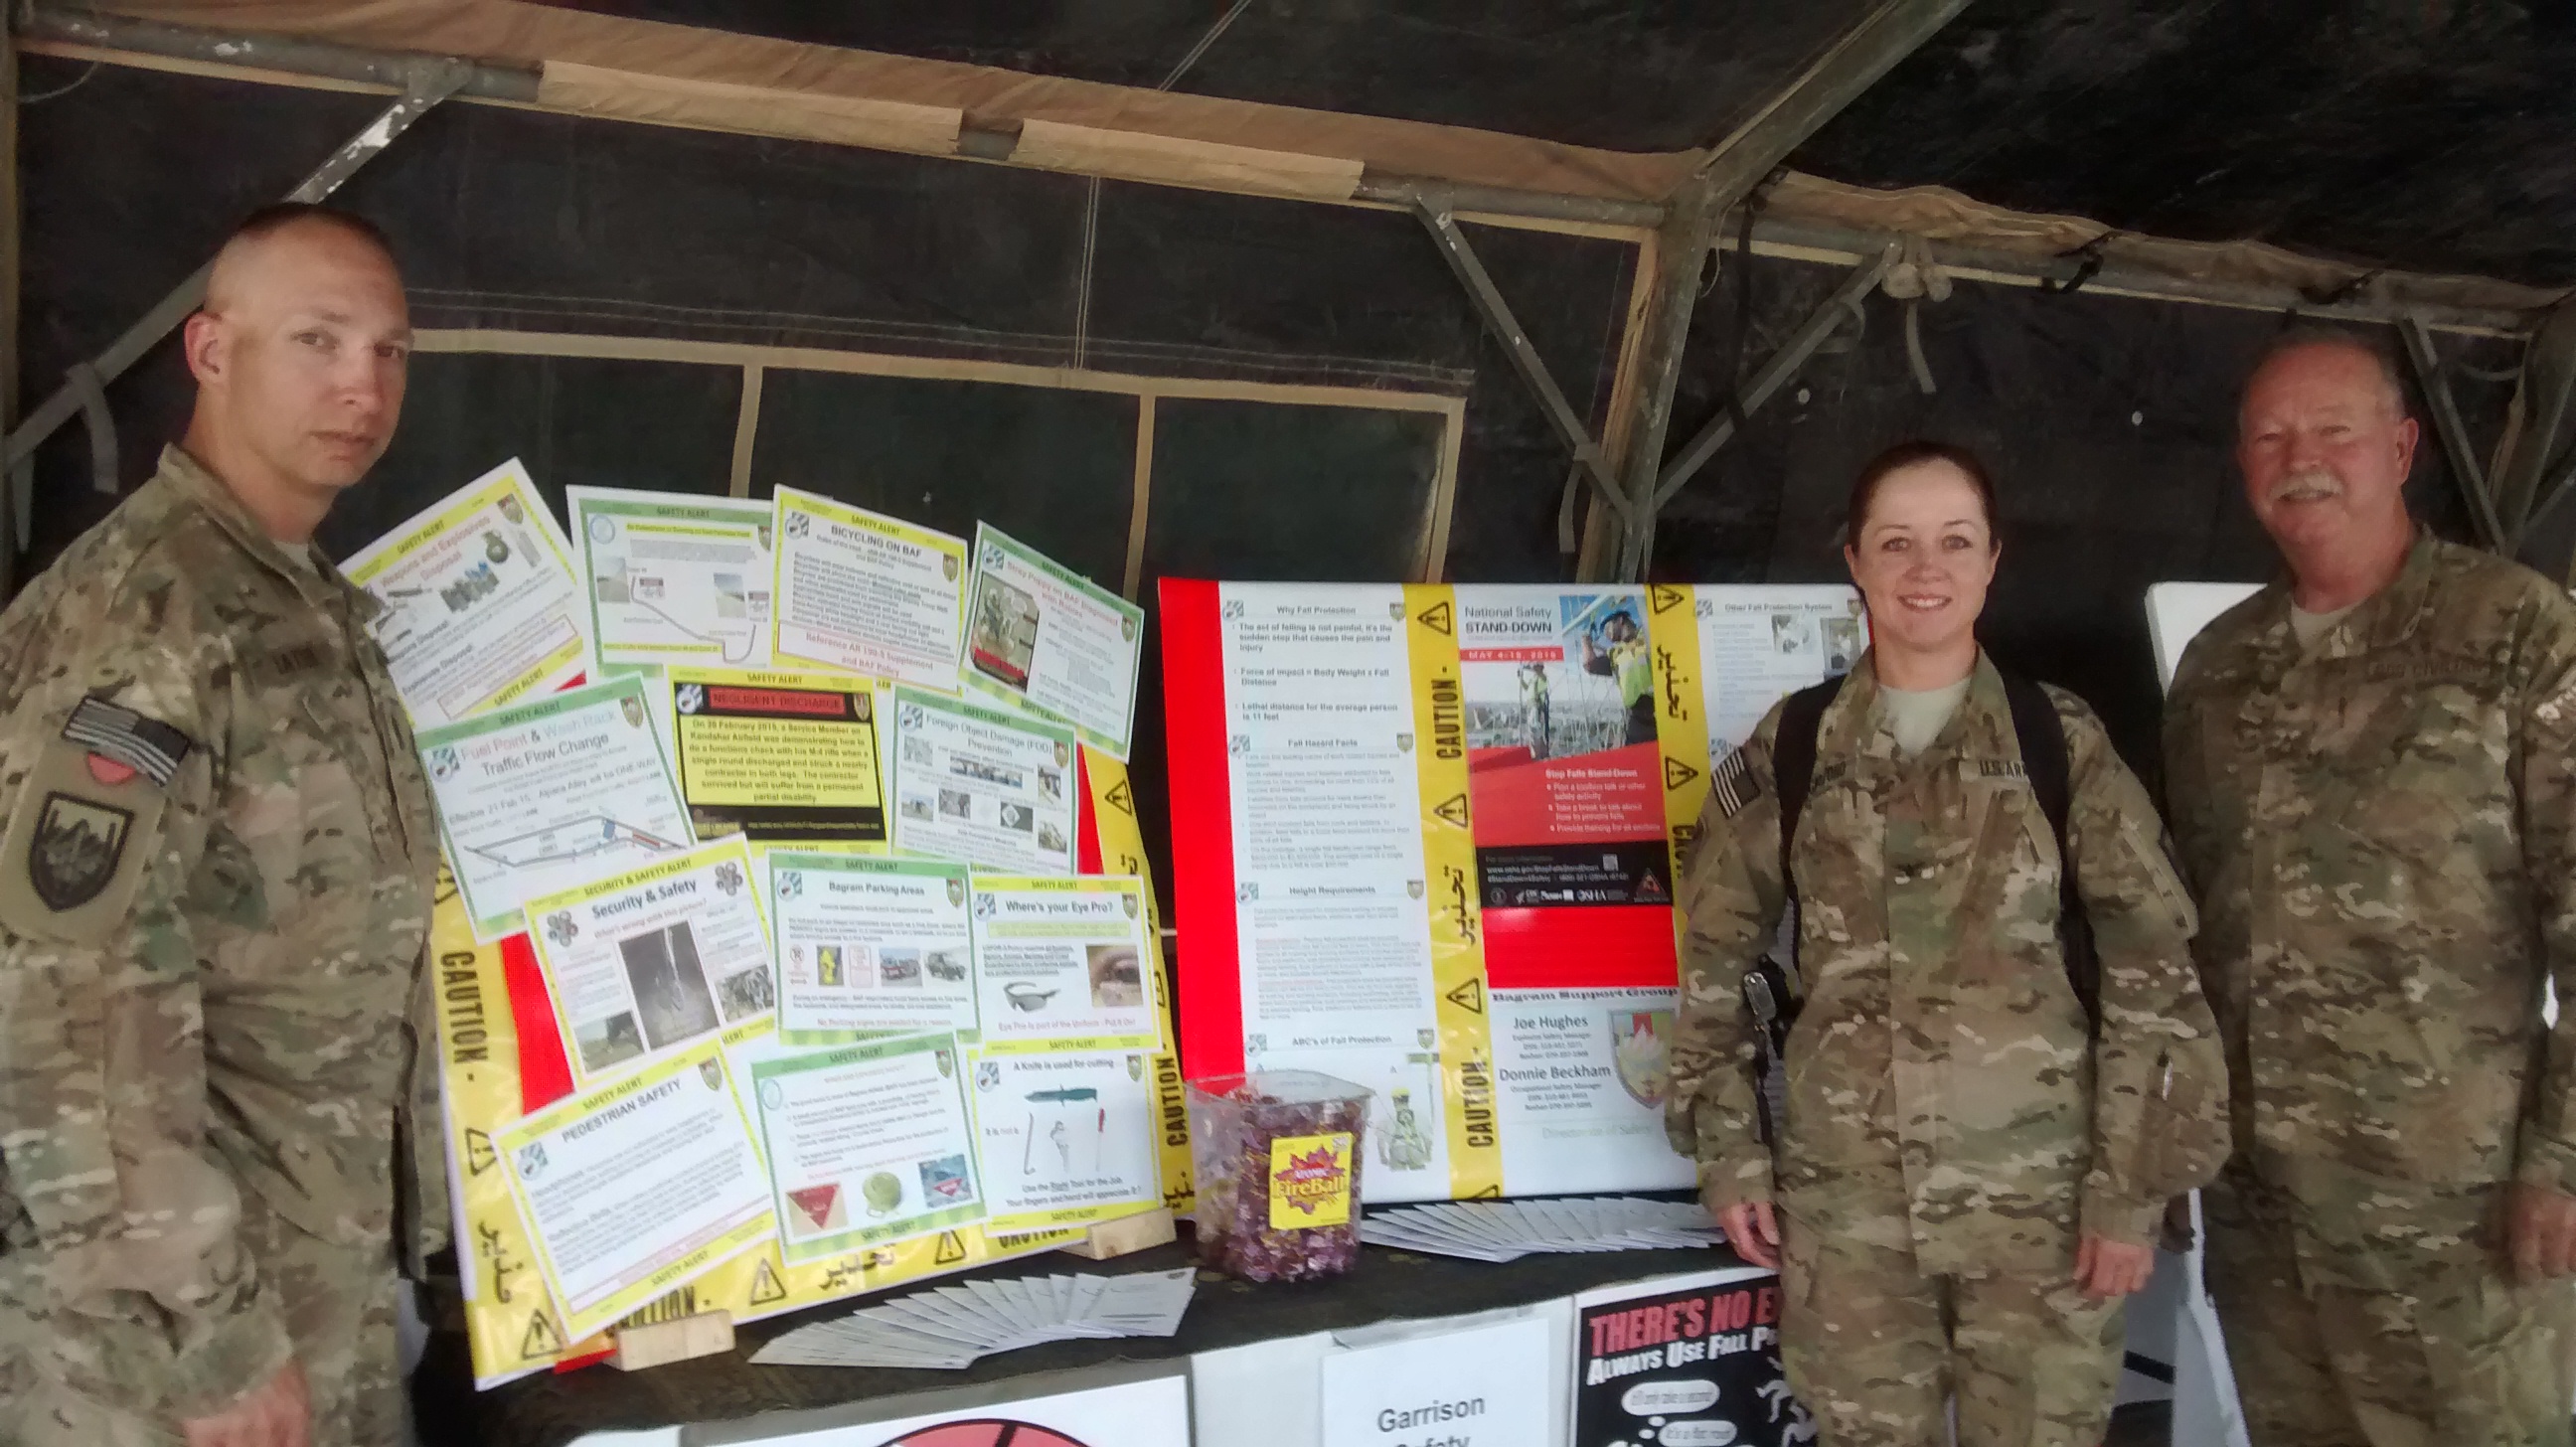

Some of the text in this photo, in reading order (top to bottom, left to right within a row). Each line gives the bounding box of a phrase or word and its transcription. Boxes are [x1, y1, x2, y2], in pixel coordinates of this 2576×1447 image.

[831, 525, 922, 558] BICYCLING ON BAF
[1465, 606, 1551, 619] National Safety
[747, 674, 803, 684] SAFETY ALERT
[461, 709, 617, 761] Fuel Point & Wash Rack
[1431, 679, 1463, 760] CAUTION
[482, 753, 523, 777] Traffic
[525, 745, 557, 765] Flow
[559, 732, 610, 758] Change
[2006, 760, 2024, 777] AR
[591, 879, 697, 919] Security & Safety
[829, 881, 924, 895] Bagram Parking Areas
[1006, 900, 1113, 914] Where's your Eye Pro?
[439, 950, 488, 1064] CAUTION
[1513, 1015, 1589, 1031] Joe Hughes
[1500, 1065, 1612, 1081] Donnie Beckham
[562, 1078, 683, 1143] PEDESTRIAN SAFETY
[1156, 1056, 1189, 1147] CAUTION
[1460, 1060, 1494, 1149] CAUTION
[1272, 1176, 1344, 1199] FireBall
[1589, 1297, 1706, 1358] THERE'S
[1709, 1290, 1752, 1334] NO
[1377, 1397, 1486, 1433] Garrison
